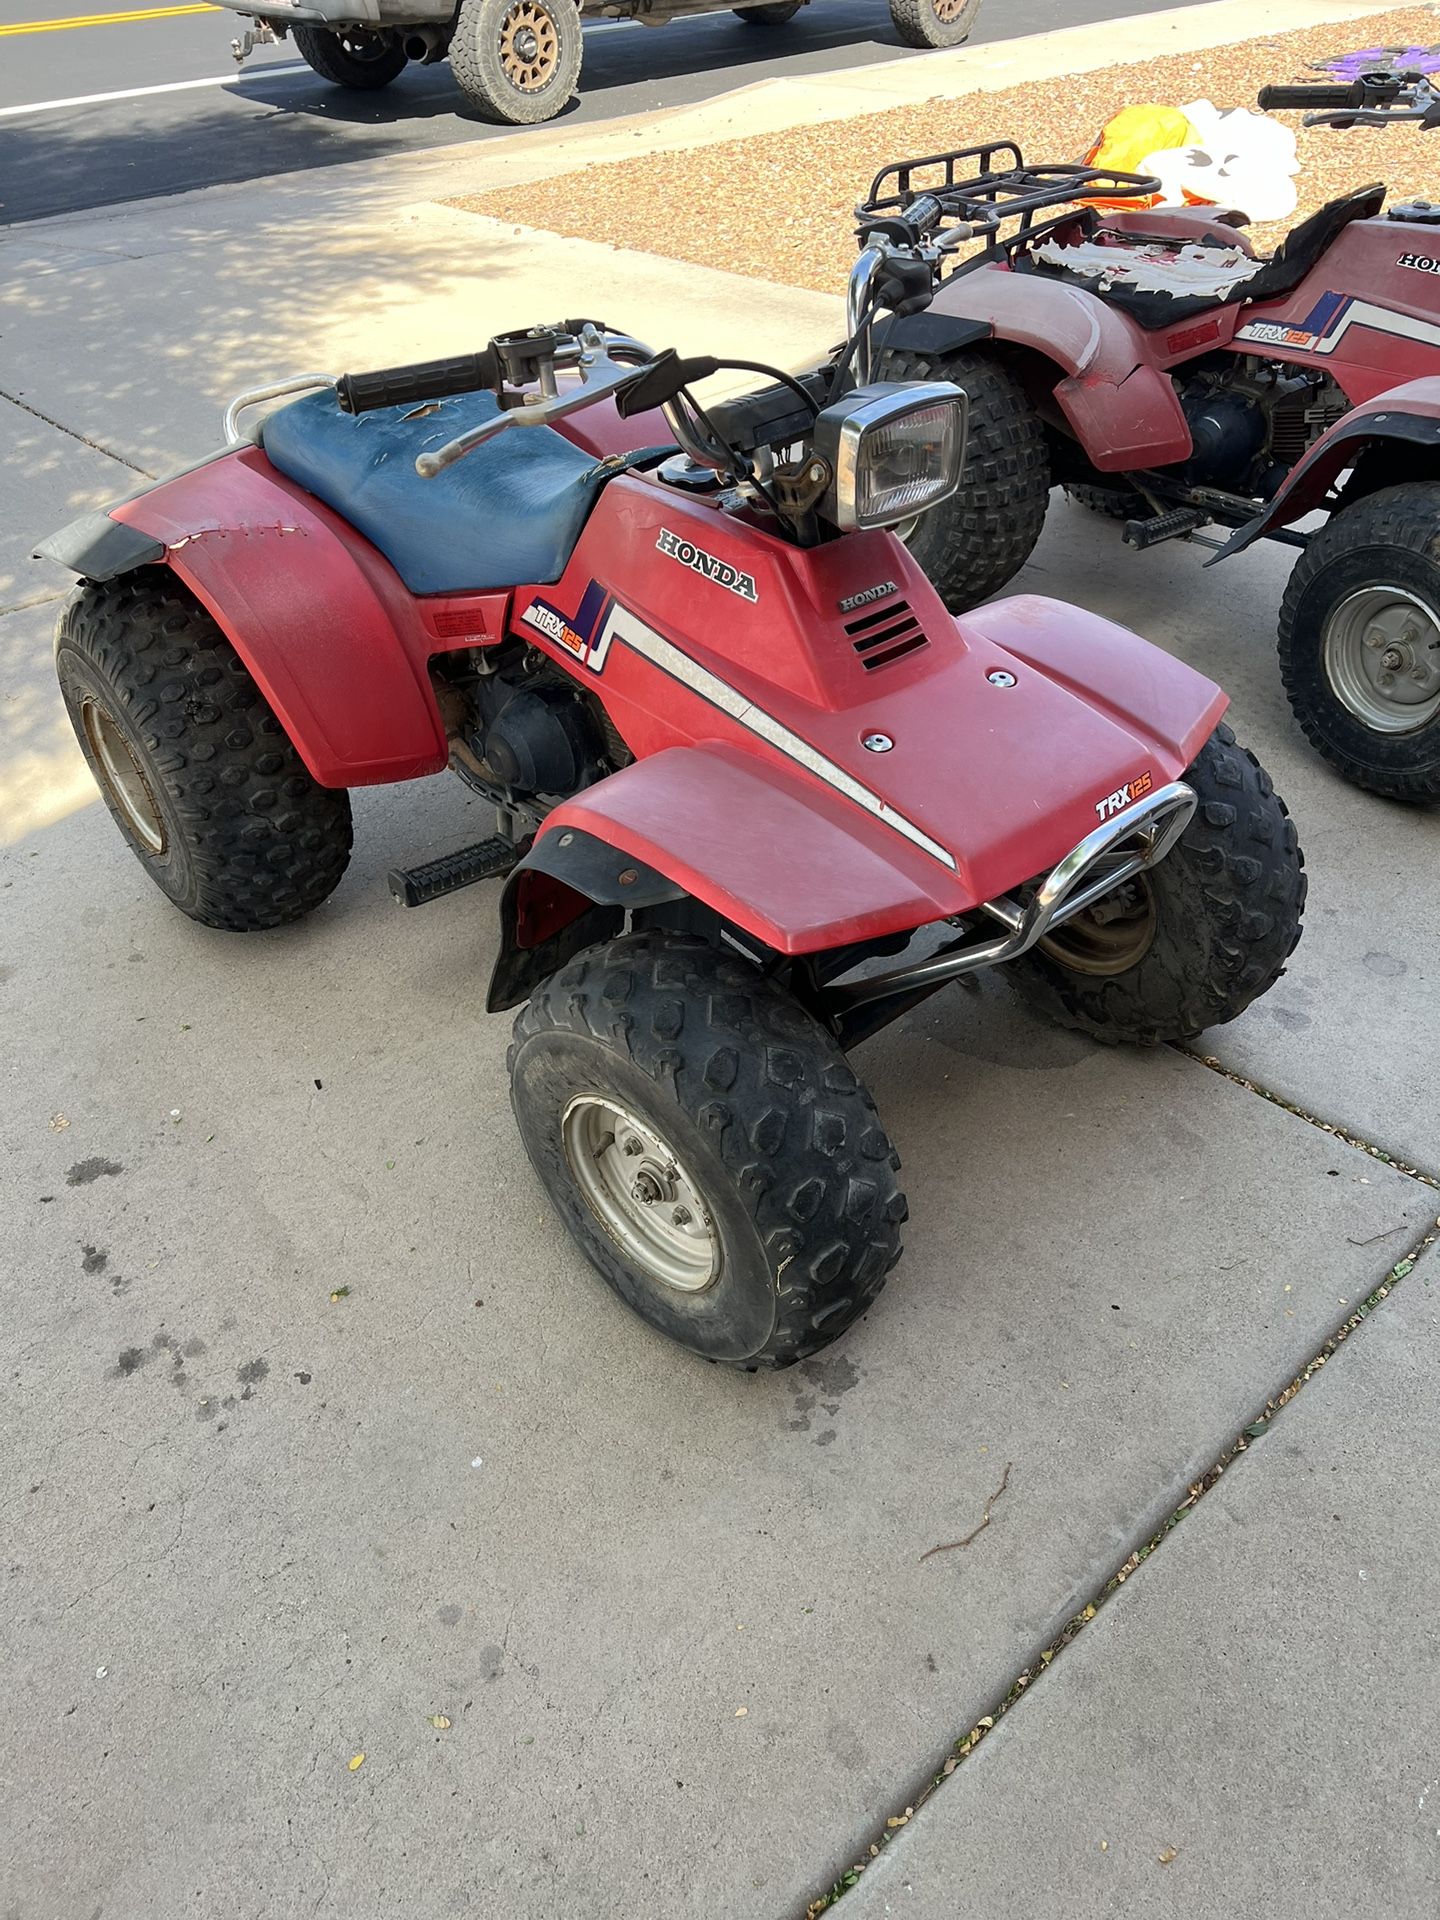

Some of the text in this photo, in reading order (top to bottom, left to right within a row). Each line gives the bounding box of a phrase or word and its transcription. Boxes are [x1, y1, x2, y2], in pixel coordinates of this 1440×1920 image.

[1250, 323, 1313, 346] TRX125
[656, 528, 758, 602] HONDA
[840, 581, 899, 611] HONDA
[535, 604, 583, 652] TRX125
[1095, 770, 1152, 821] TRX125
